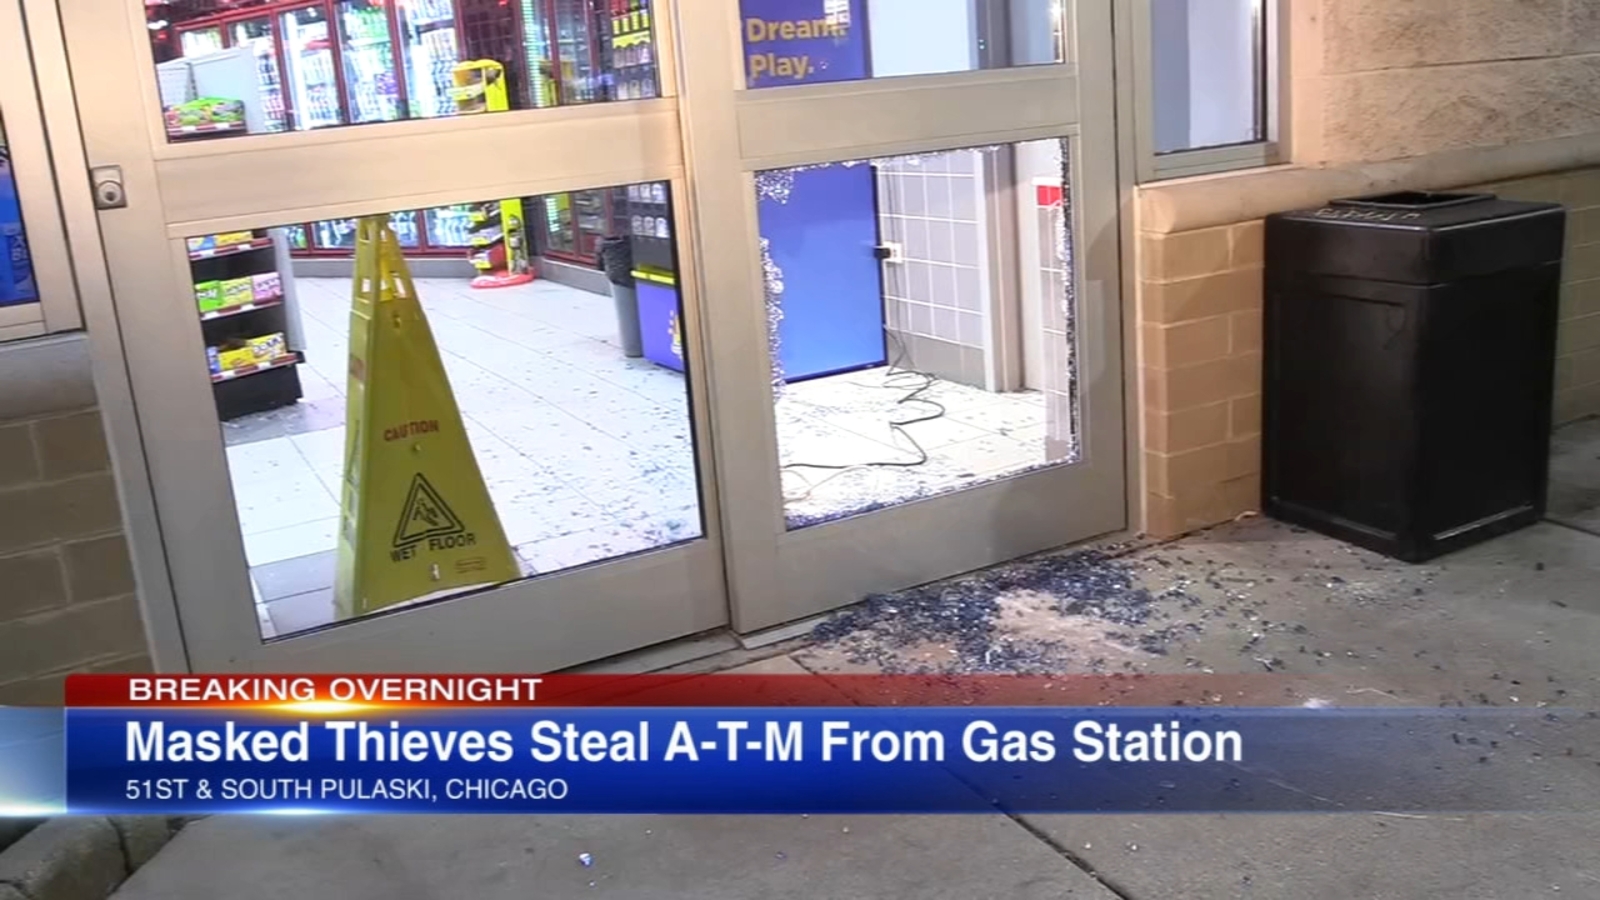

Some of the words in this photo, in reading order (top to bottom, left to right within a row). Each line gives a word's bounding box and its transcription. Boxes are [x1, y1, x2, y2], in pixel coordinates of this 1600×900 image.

[749, 52, 815, 79] Play.
[384, 419, 439, 442] CAUTION
[390, 545, 416, 562] WET
[429, 532, 477, 551] FLOOR
